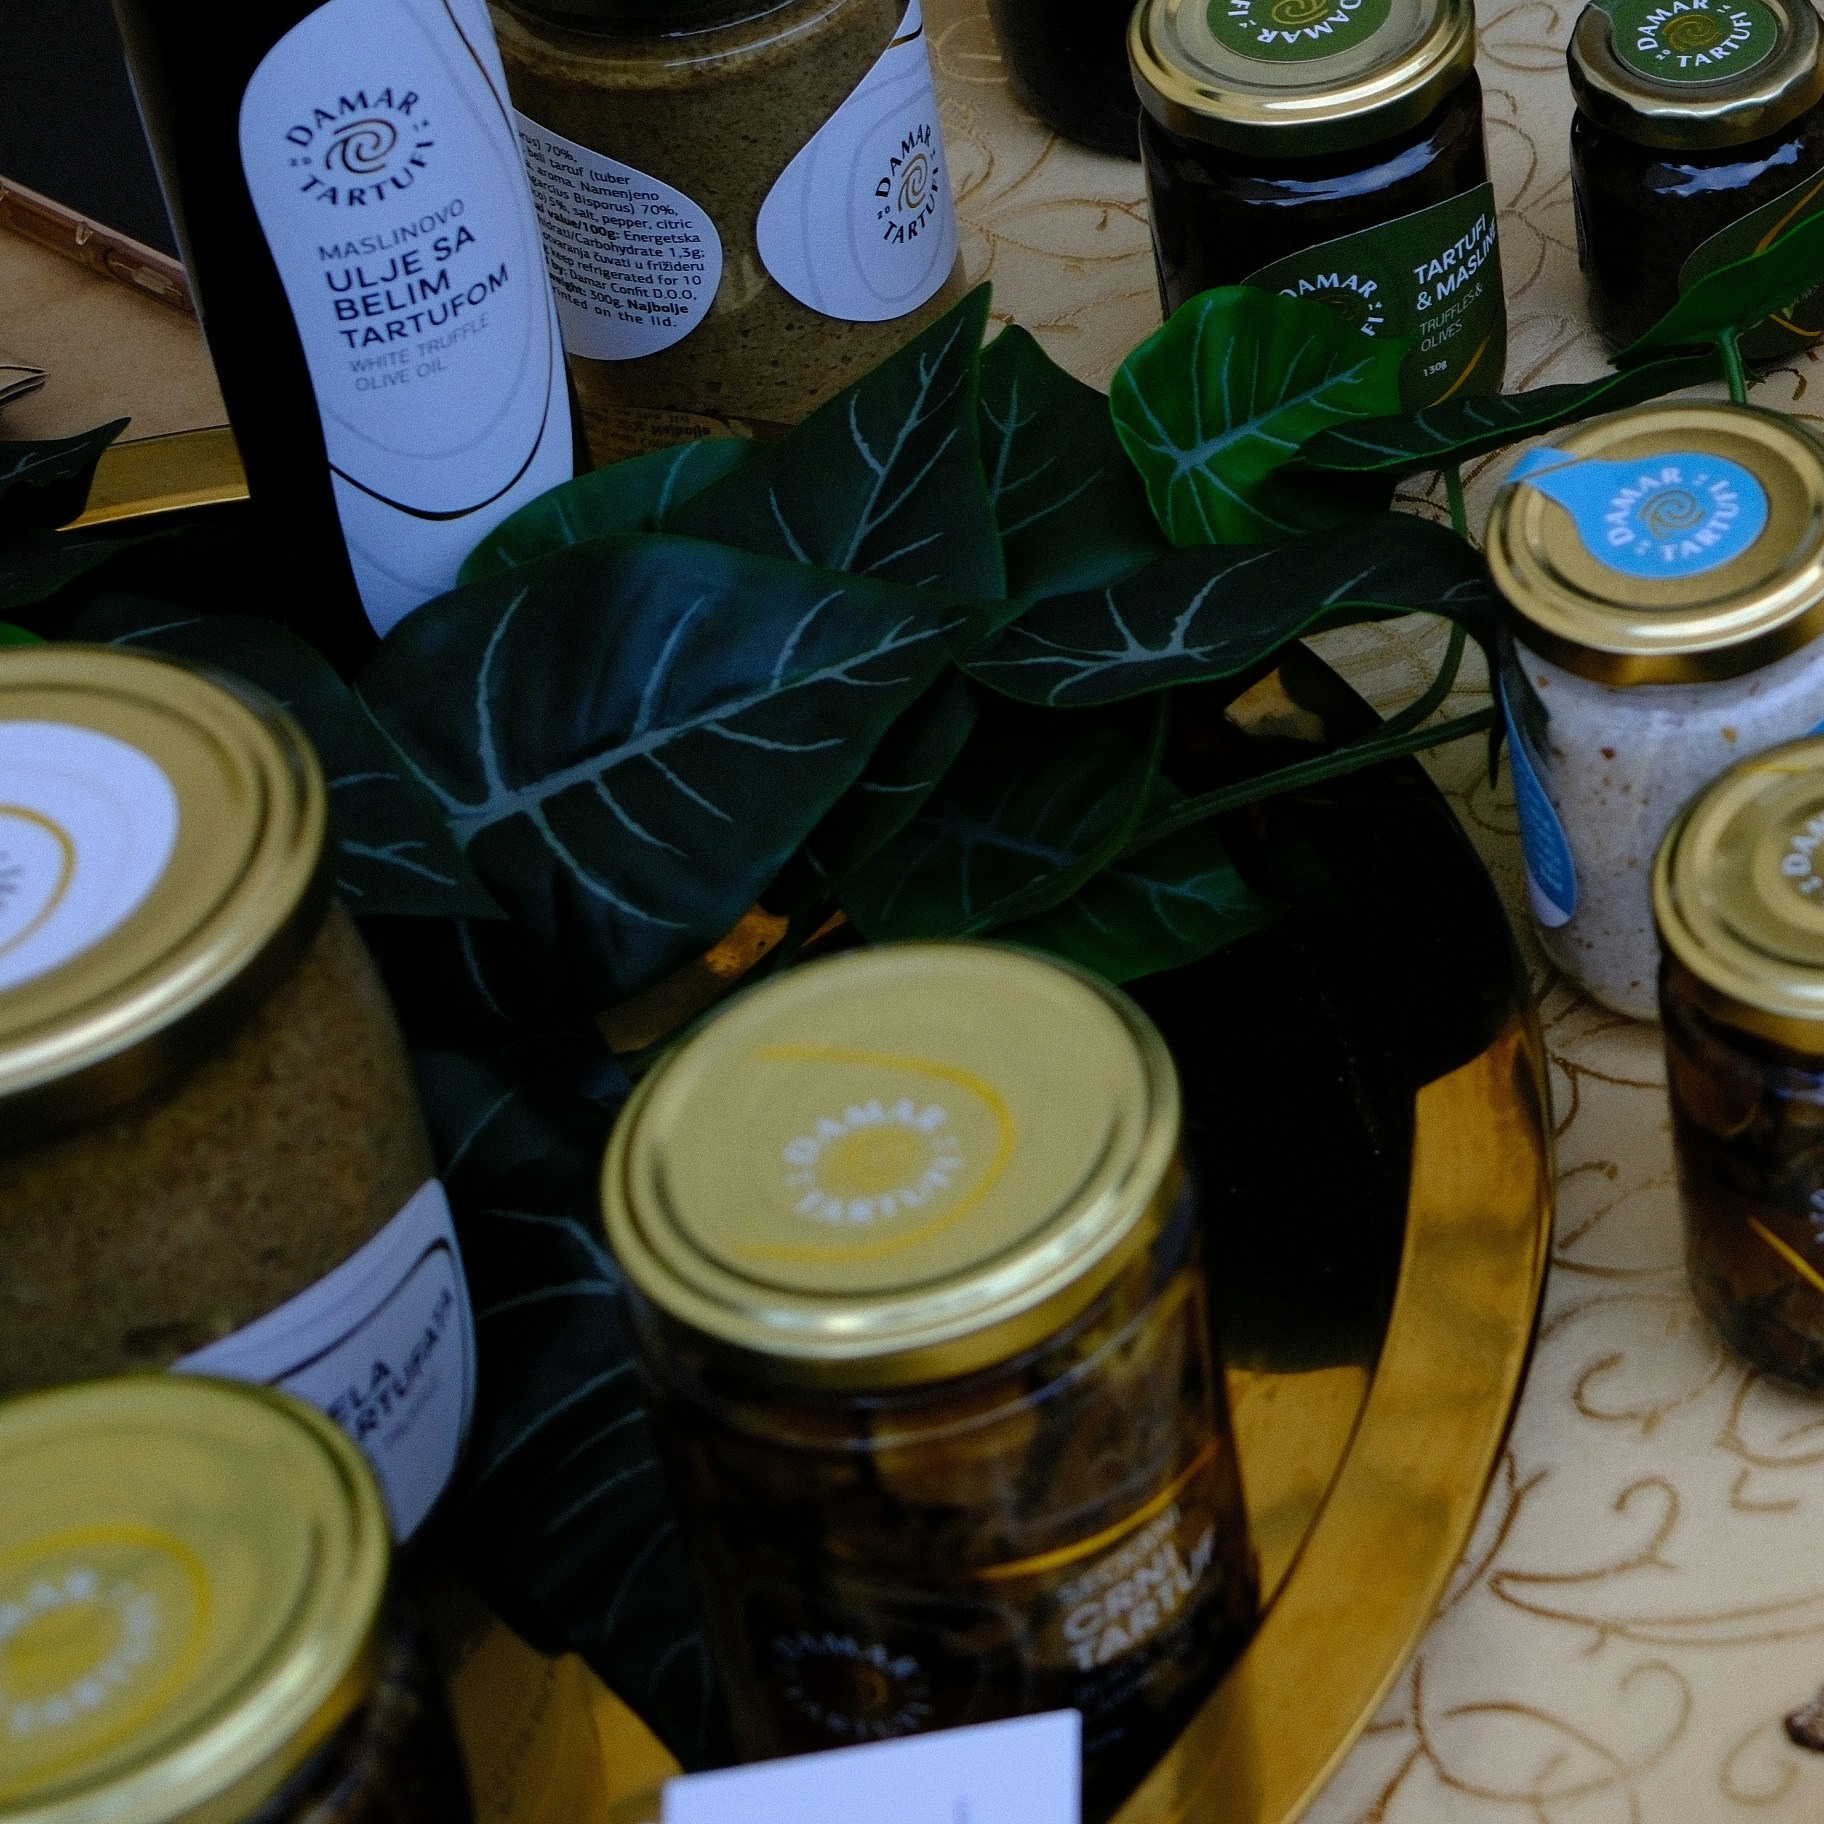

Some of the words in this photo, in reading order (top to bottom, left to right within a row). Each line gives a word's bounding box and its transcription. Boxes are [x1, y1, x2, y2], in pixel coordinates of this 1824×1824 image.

[1675, 10, 1753, 69] TARTUFI
[285, 87, 419, 148] DAMAR
[300, 139, 435, 208] TARTUFI
[590, 169, 631, 186] (tuber
[875, 122, 932, 199] DAMAR
[573, 191, 635, 216] Bisporus)
[642, 204, 679, 217] 70%,
[580, 181, 660, 202] Namenjeno
[882, 166, 941, 245] TARTUFI
[318, 198, 466, 262] MASLINOVO
[623, 230, 701, 246] Energetska
[655, 218, 694, 230] citric
[325, 248, 425, 293] ULJE
[434, 225, 476, 263] SA
[593, 248, 632, 269] čuvati
[635, 260, 644, 271] u
[647, 259, 705, 273] frižideru
[1412, 213, 1489, 283] TARTUFI
[334, 269, 452, 322] BELIM
[569, 268, 608, 291] Damar
[610, 281, 652, 299] Confit
[577, 261, 654, 286] refrigerated
[658, 273, 679, 286] for
[684, 275, 702, 286] 10
[340, 261, 511, 350] TARTUFOM
[595, 306, 612, 318] on
[618, 310, 645, 325] the
[650, 315, 678, 327] lid.
[627, 298, 689, 317] Najbolje
[1415, 290, 1434, 312] &
[1419, 317, 1464, 352] OLIVES
[350, 349, 411, 376] WHITE
[354, 368, 411, 393] OLIVE
[418, 357, 449, 380] OIL
[1604, 466, 1684, 548] DAMAR
[1658, 476, 1742, 563] TARTUFI
[785, 1097, 962, 1163] DAMAR
[795, 1153, 972, 1220] TARTUFI
